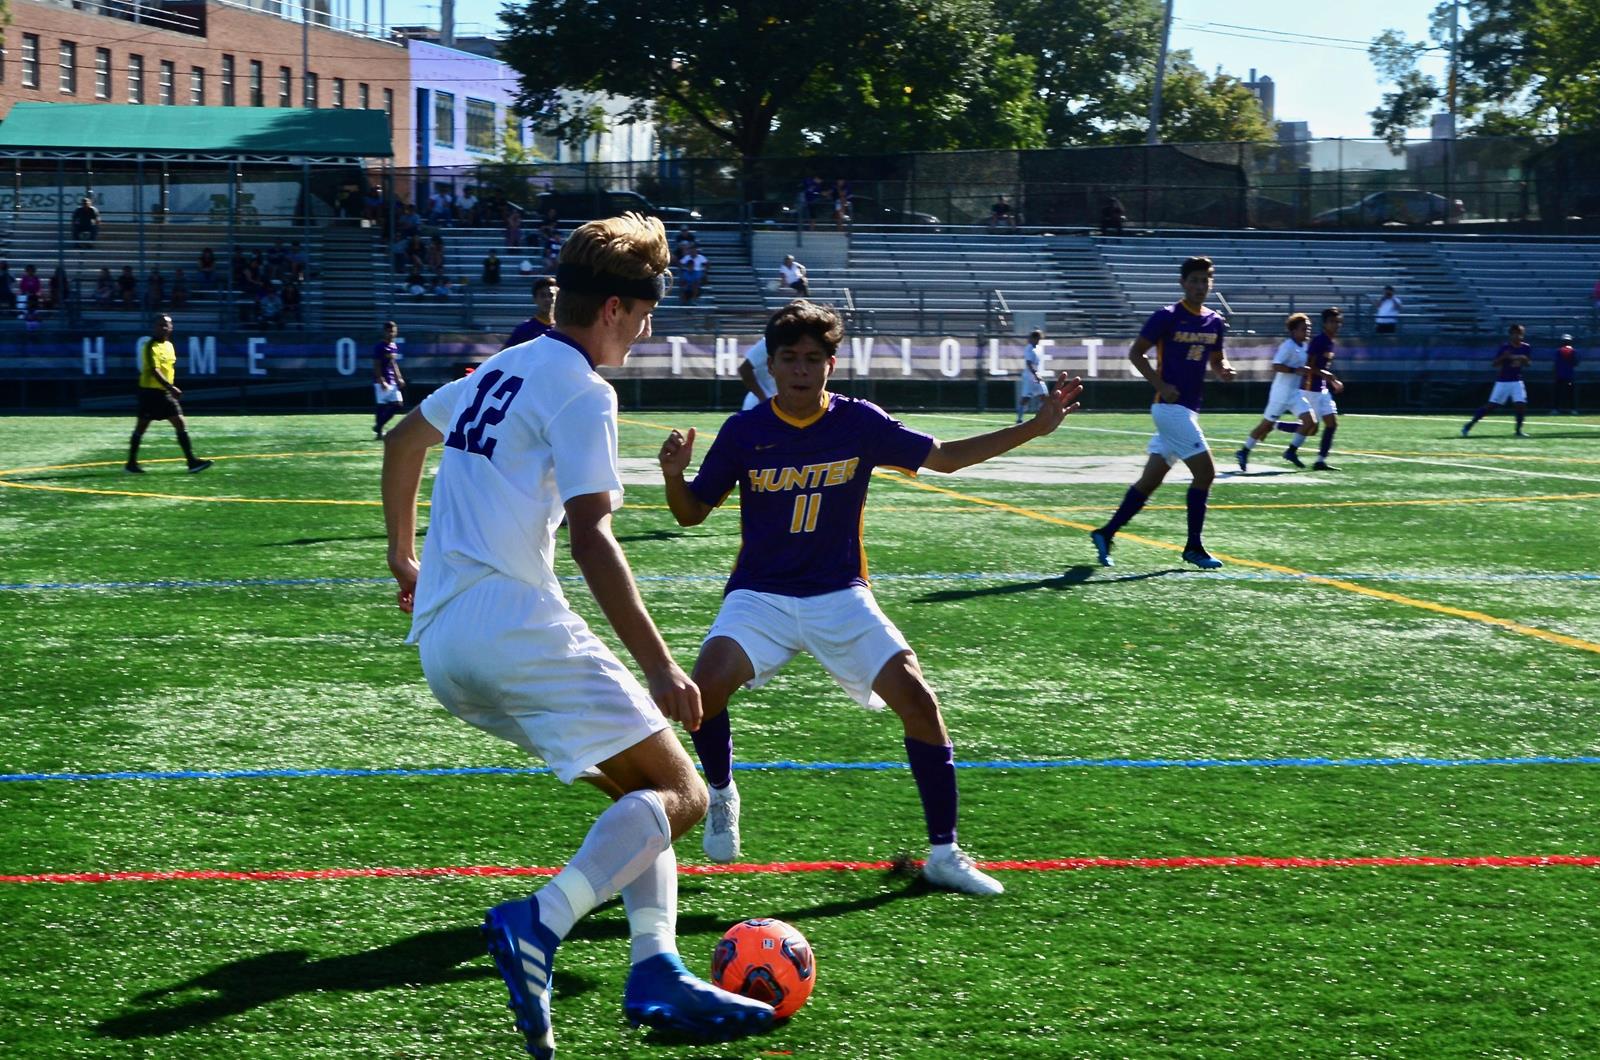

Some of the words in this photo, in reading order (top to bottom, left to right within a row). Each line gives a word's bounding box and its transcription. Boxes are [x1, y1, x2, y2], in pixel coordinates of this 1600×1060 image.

[82, 336, 267, 375] HME
[335, 336, 406, 376] O
[666, 336, 739, 376] TH
[851, 337, 1145, 377] VIOLET
[444, 369, 524, 461] 12
[748, 457, 860, 493] HUNTER
[790, 493, 822, 534] 11
